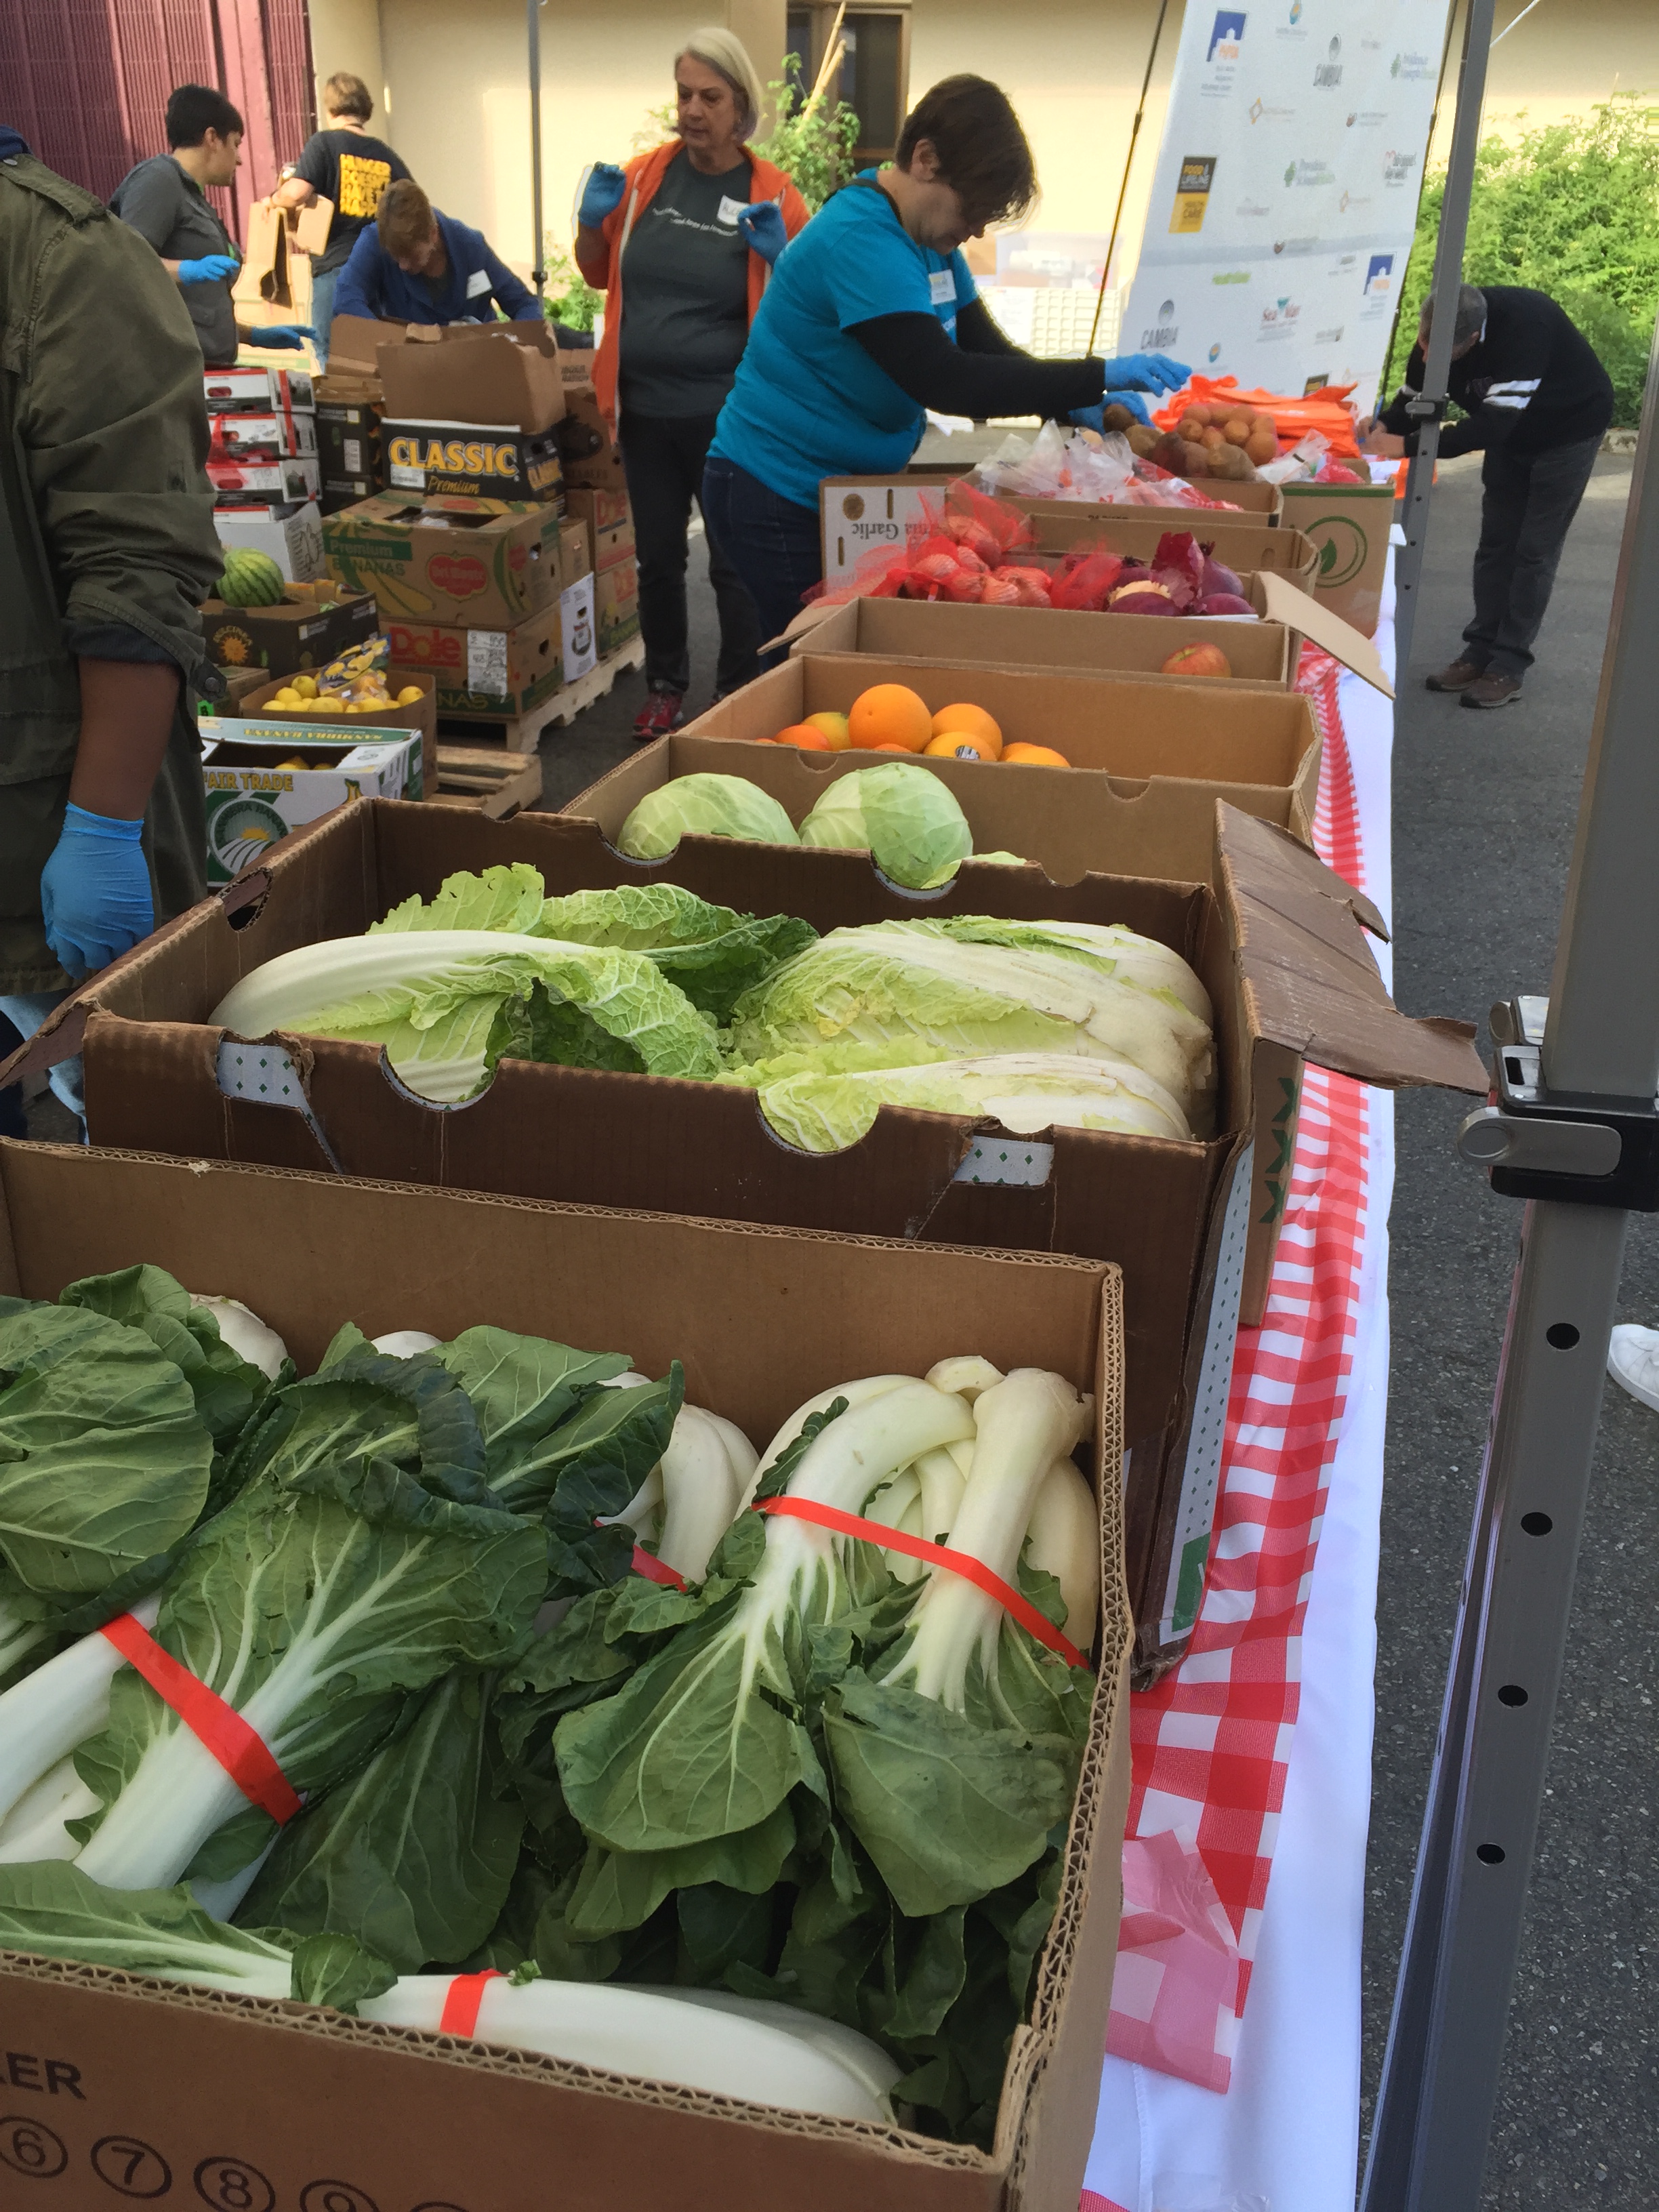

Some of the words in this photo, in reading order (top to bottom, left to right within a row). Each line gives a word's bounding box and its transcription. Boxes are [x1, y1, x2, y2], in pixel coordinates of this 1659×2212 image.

[340, 154, 391, 175] HUNGER
[388, 437, 520, 477] CLASSIC
[428, 475, 480, 495] Premium
[852, 523, 899, 540] Garlic
[330, 539, 393, 557] Premium
[332, 558, 405, 577] BNANAS
[390, 626, 462, 661] Dole
[436, 691, 489, 710] NAS
[240, 773, 293, 792] TRADE
[0, 2051, 87, 2101] ER
[12, 2128, 46, 2167] 6
[110, 2145, 144, 2186] 7
[218, 2168, 253, 2210] 8
